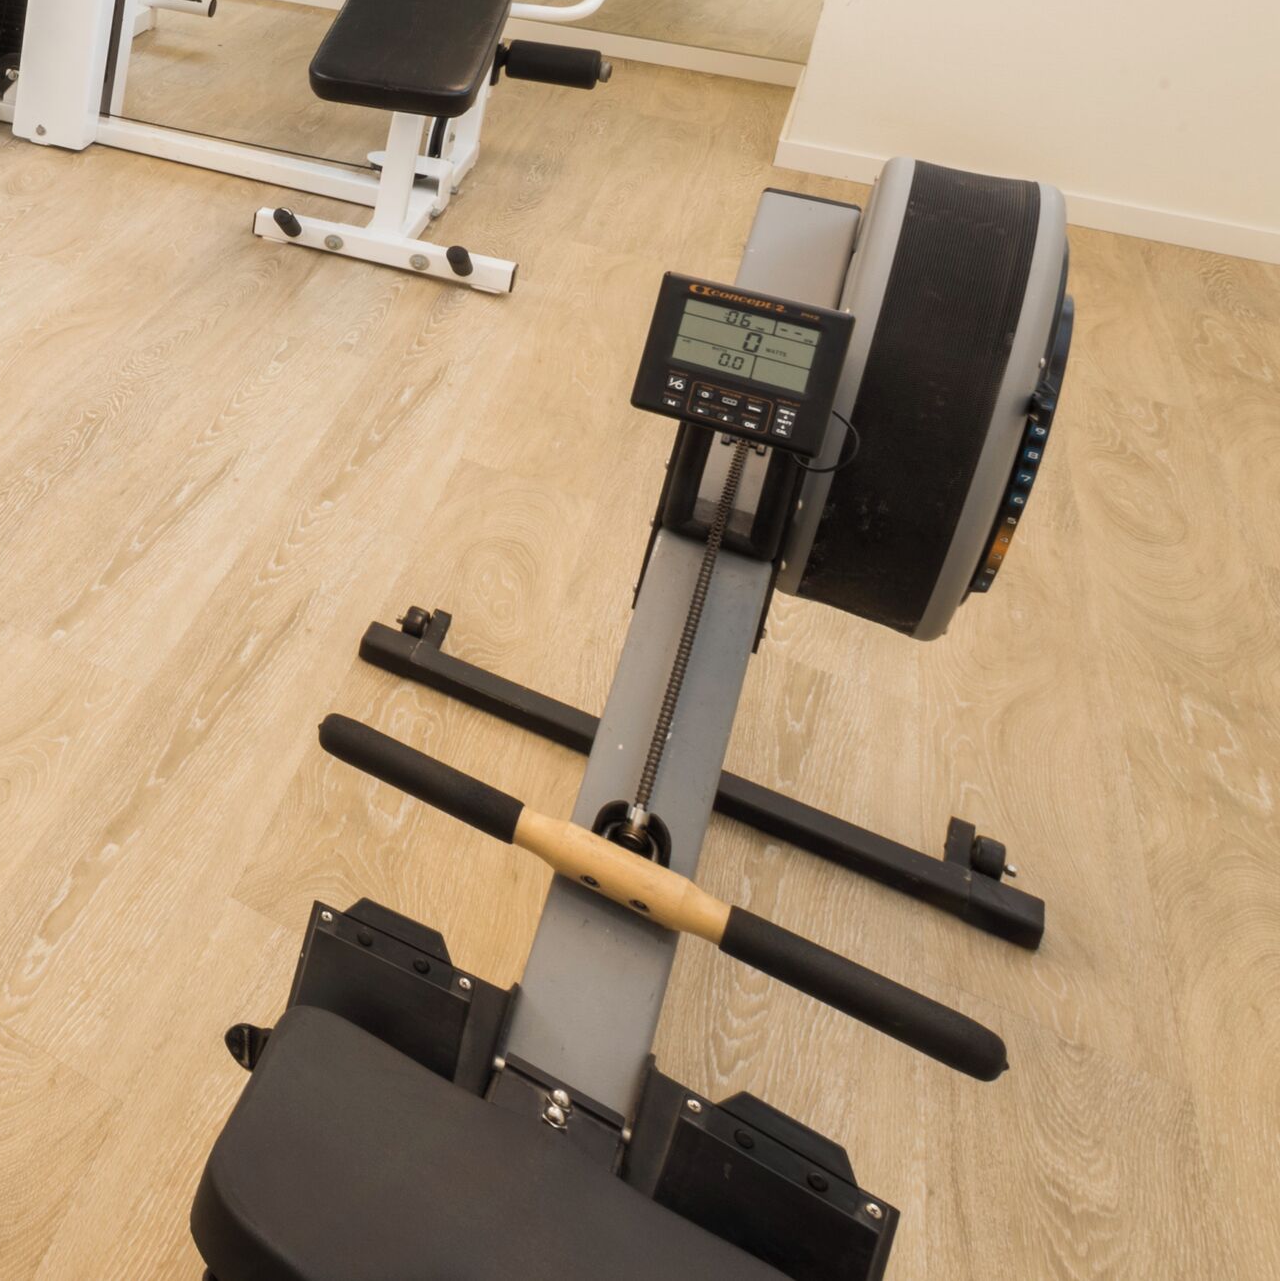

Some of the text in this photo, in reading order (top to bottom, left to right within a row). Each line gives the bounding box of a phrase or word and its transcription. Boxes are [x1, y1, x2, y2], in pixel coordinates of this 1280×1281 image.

[711, 290, 772, 309] concept
[1035, 427, 1046, 436] 9
[1027, 451, 1039, 460] 8
[1021, 474, 1031, 482] 7
[1013, 496, 1024, 504] 6
